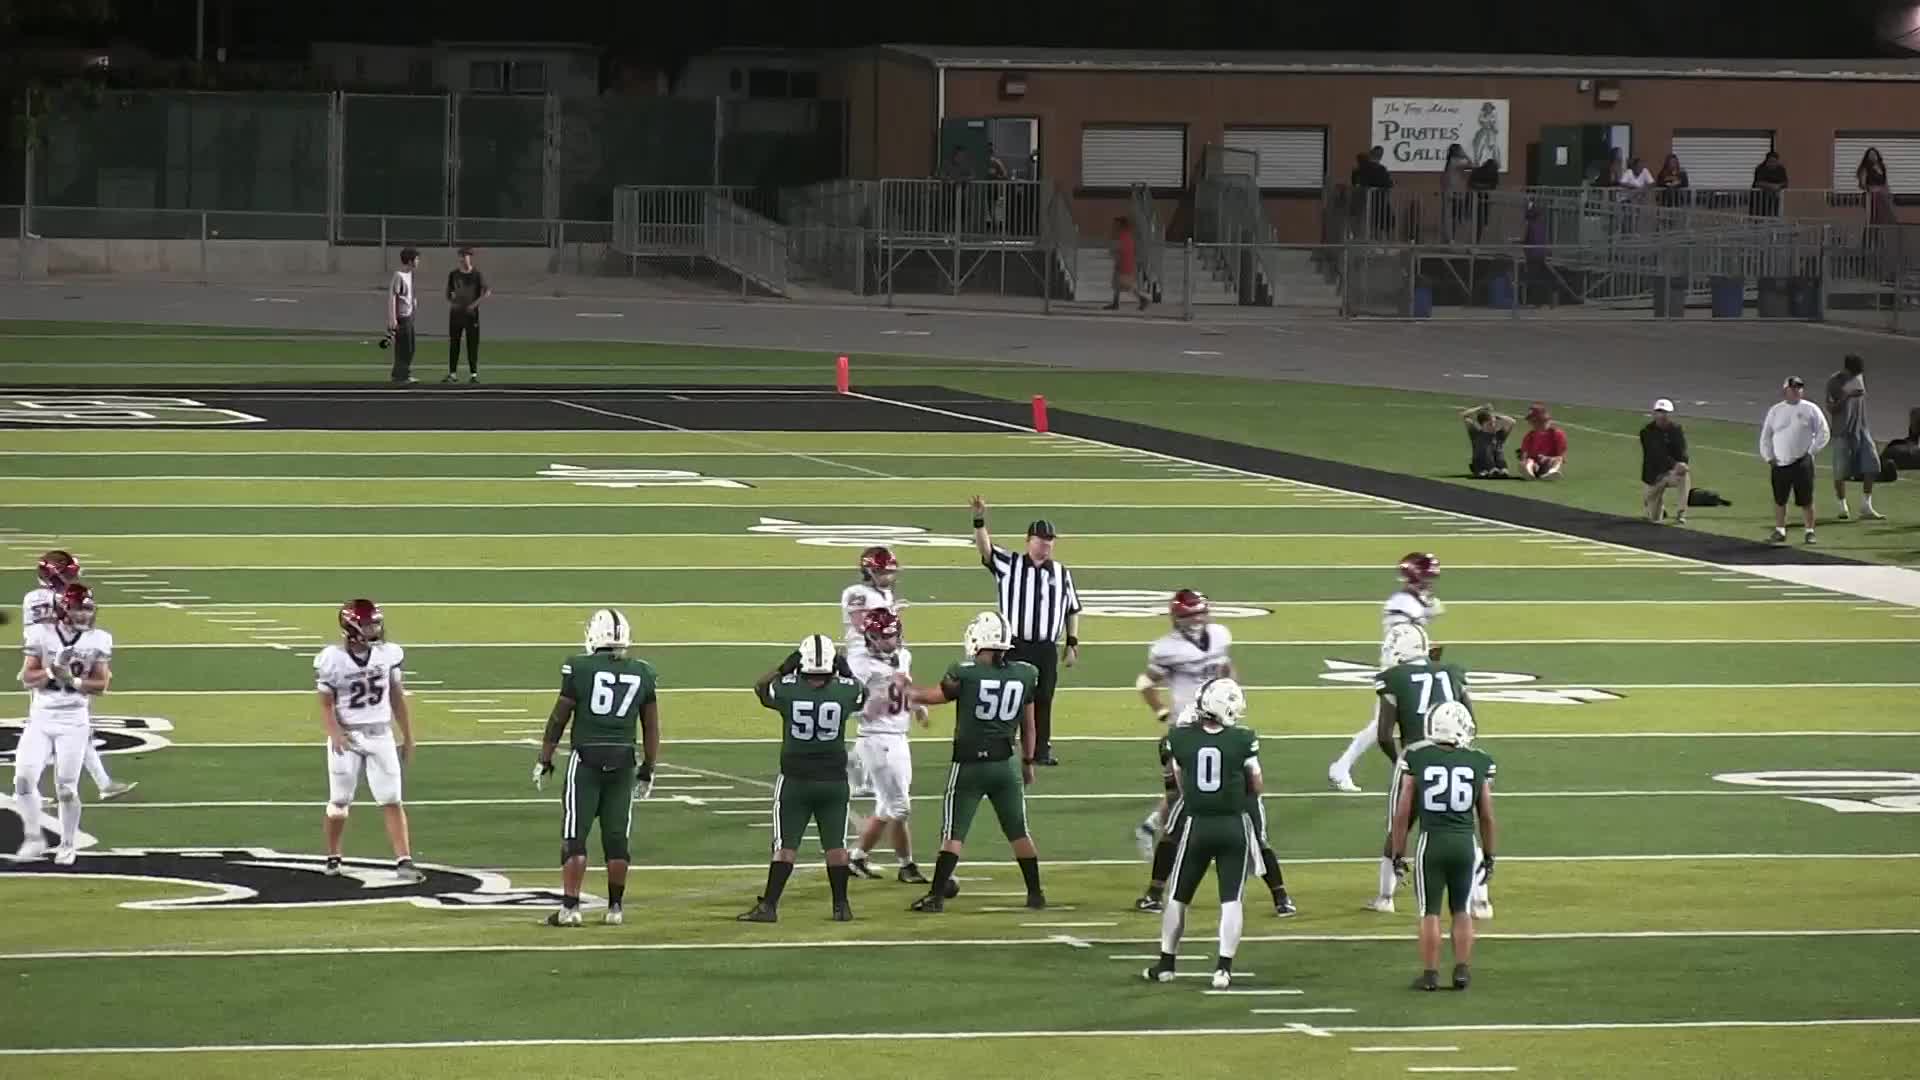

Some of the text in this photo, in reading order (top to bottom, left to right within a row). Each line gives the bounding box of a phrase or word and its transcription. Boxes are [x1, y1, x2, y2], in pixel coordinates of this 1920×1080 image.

[349, 675, 384, 709] 25
[590, 671, 641, 718] 67
[975, 679, 1025, 721] 50
[1411, 671, 1455, 715] 71
[791, 701, 842, 742] 59
[1195, 747, 1223, 792] 0
[1423, 765, 1475, 813] 26
